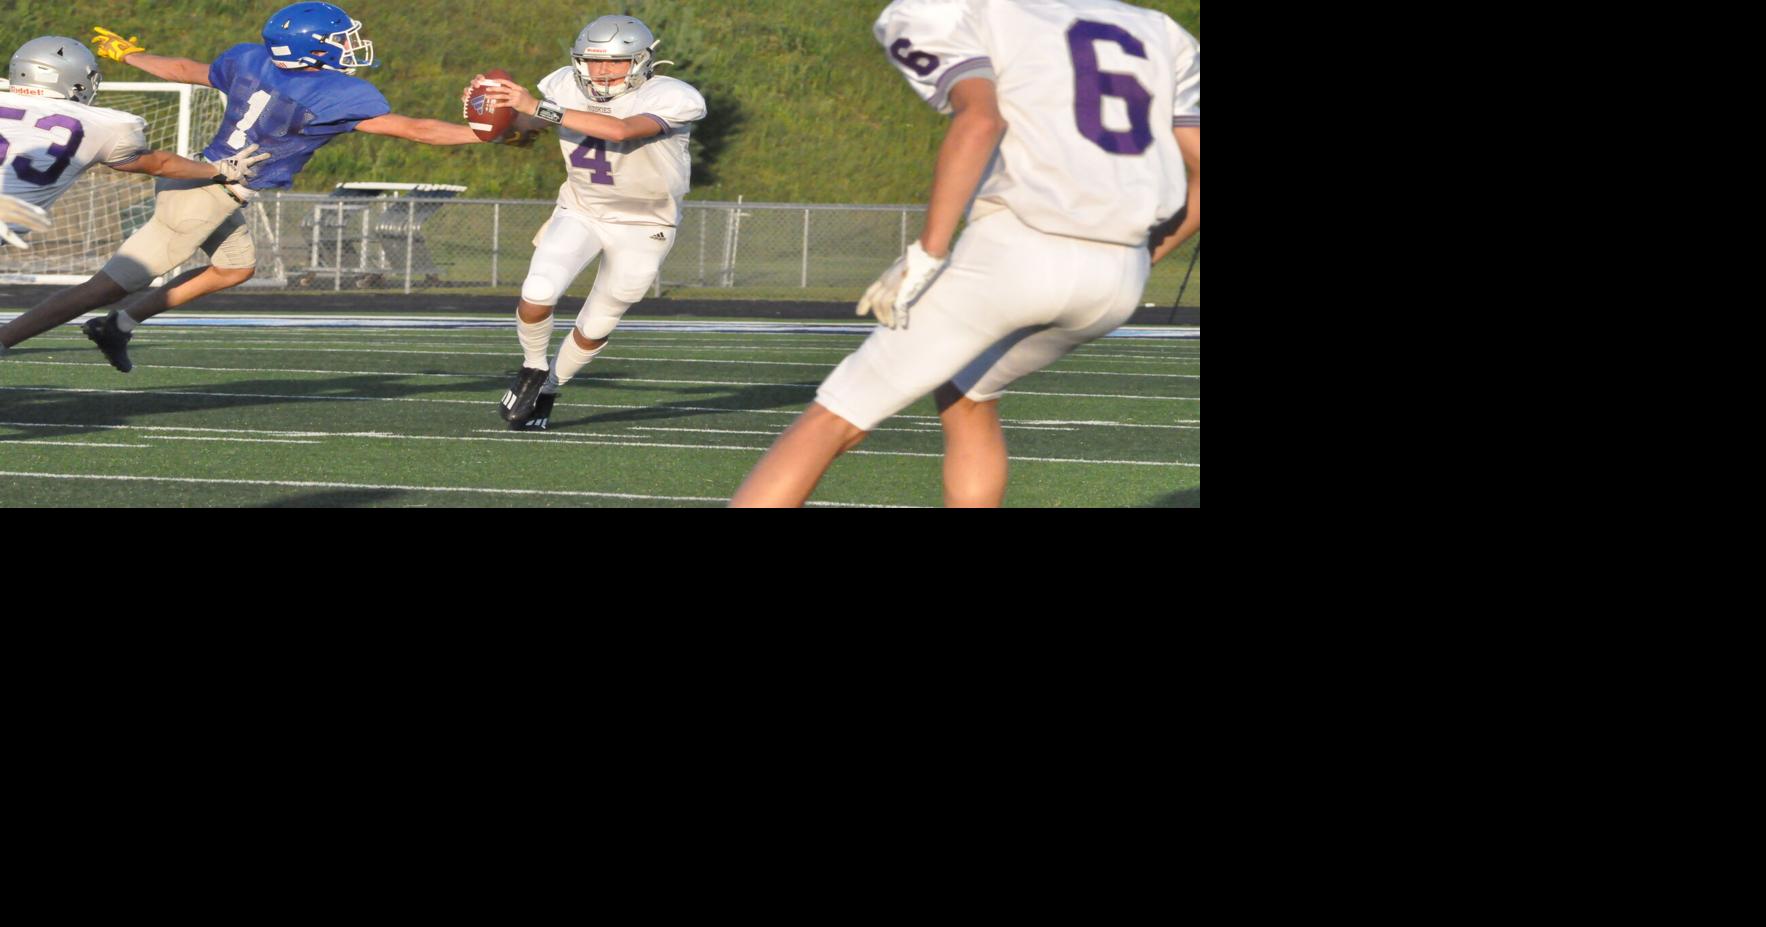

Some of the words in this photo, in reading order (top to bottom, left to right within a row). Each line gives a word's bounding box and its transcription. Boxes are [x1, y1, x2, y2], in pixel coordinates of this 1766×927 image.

[890, 37, 940, 77] 6
[1066, 18, 1154, 156] 6
[226, 90, 272, 150] 1
[569, 136, 614, 185] 4
